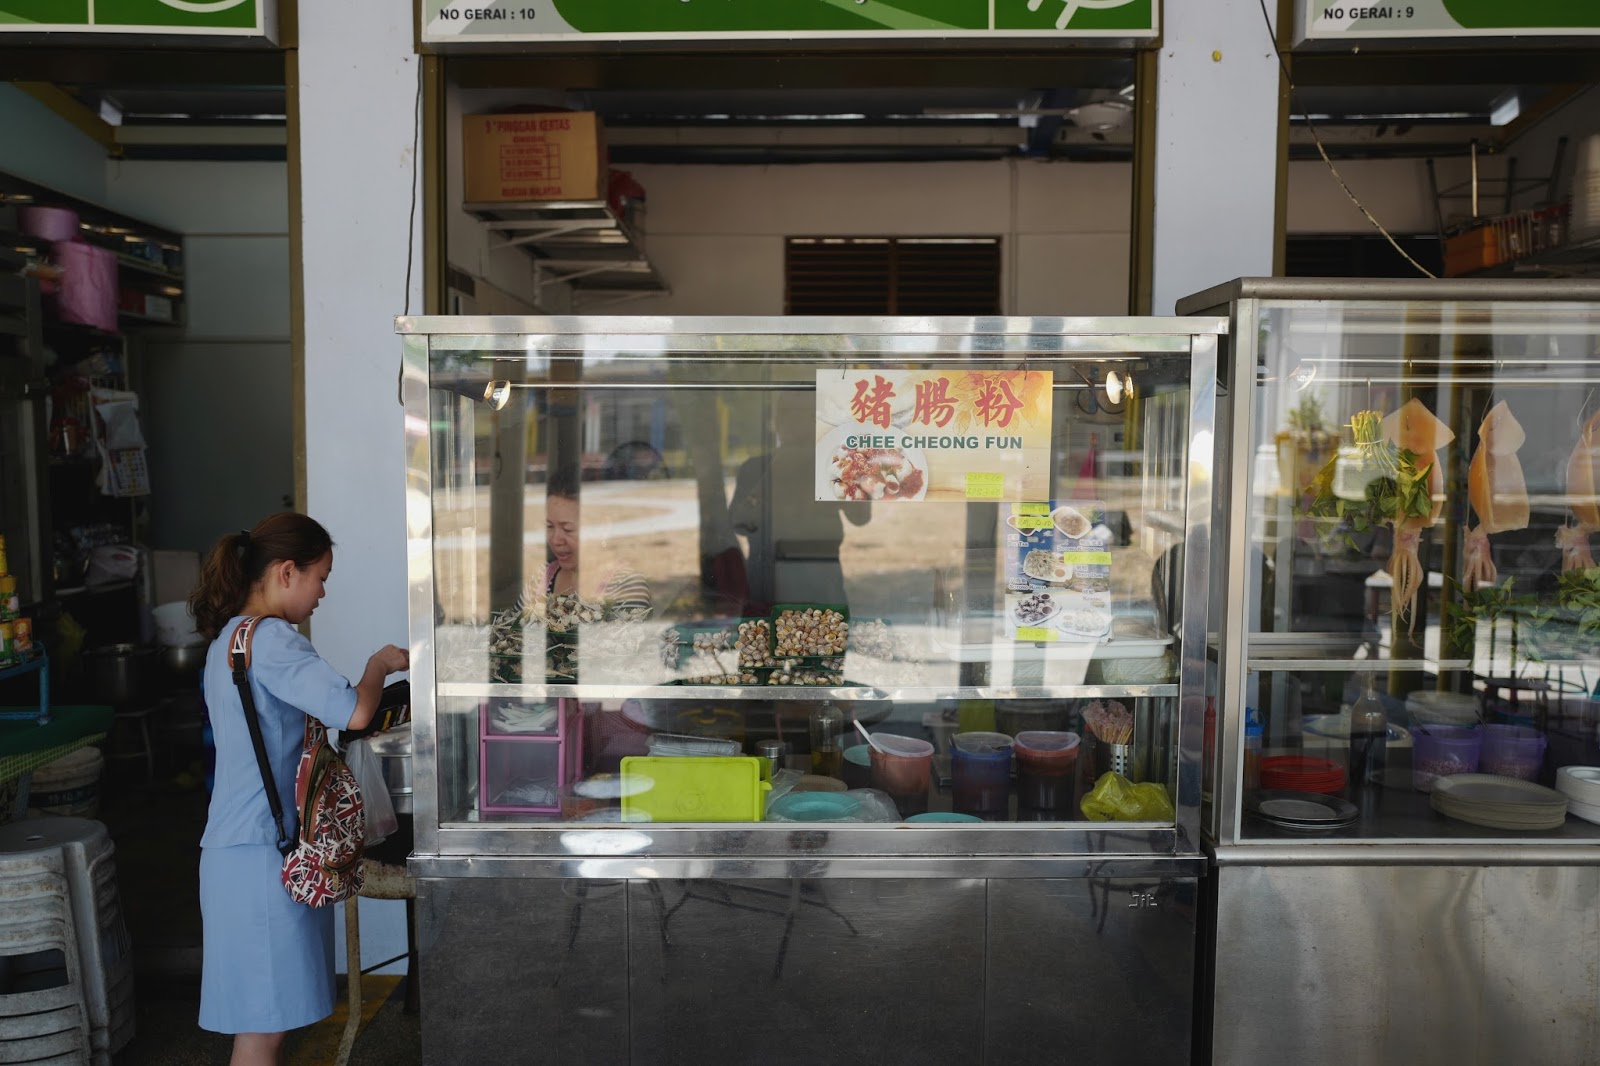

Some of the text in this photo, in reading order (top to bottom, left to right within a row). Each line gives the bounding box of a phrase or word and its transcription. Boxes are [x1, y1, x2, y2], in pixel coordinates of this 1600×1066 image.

[440, 9, 459, 20] NO
[464, 9, 506, 20] GERAI
[519, 8, 535, 20] 10
[1324, 8, 1344, 20] NO
[1349, 7, 1392, 19] GERAI
[1405, 7, 1414, 18] 9
[846, 436, 1022, 449] CHEE CHEONG FUN
